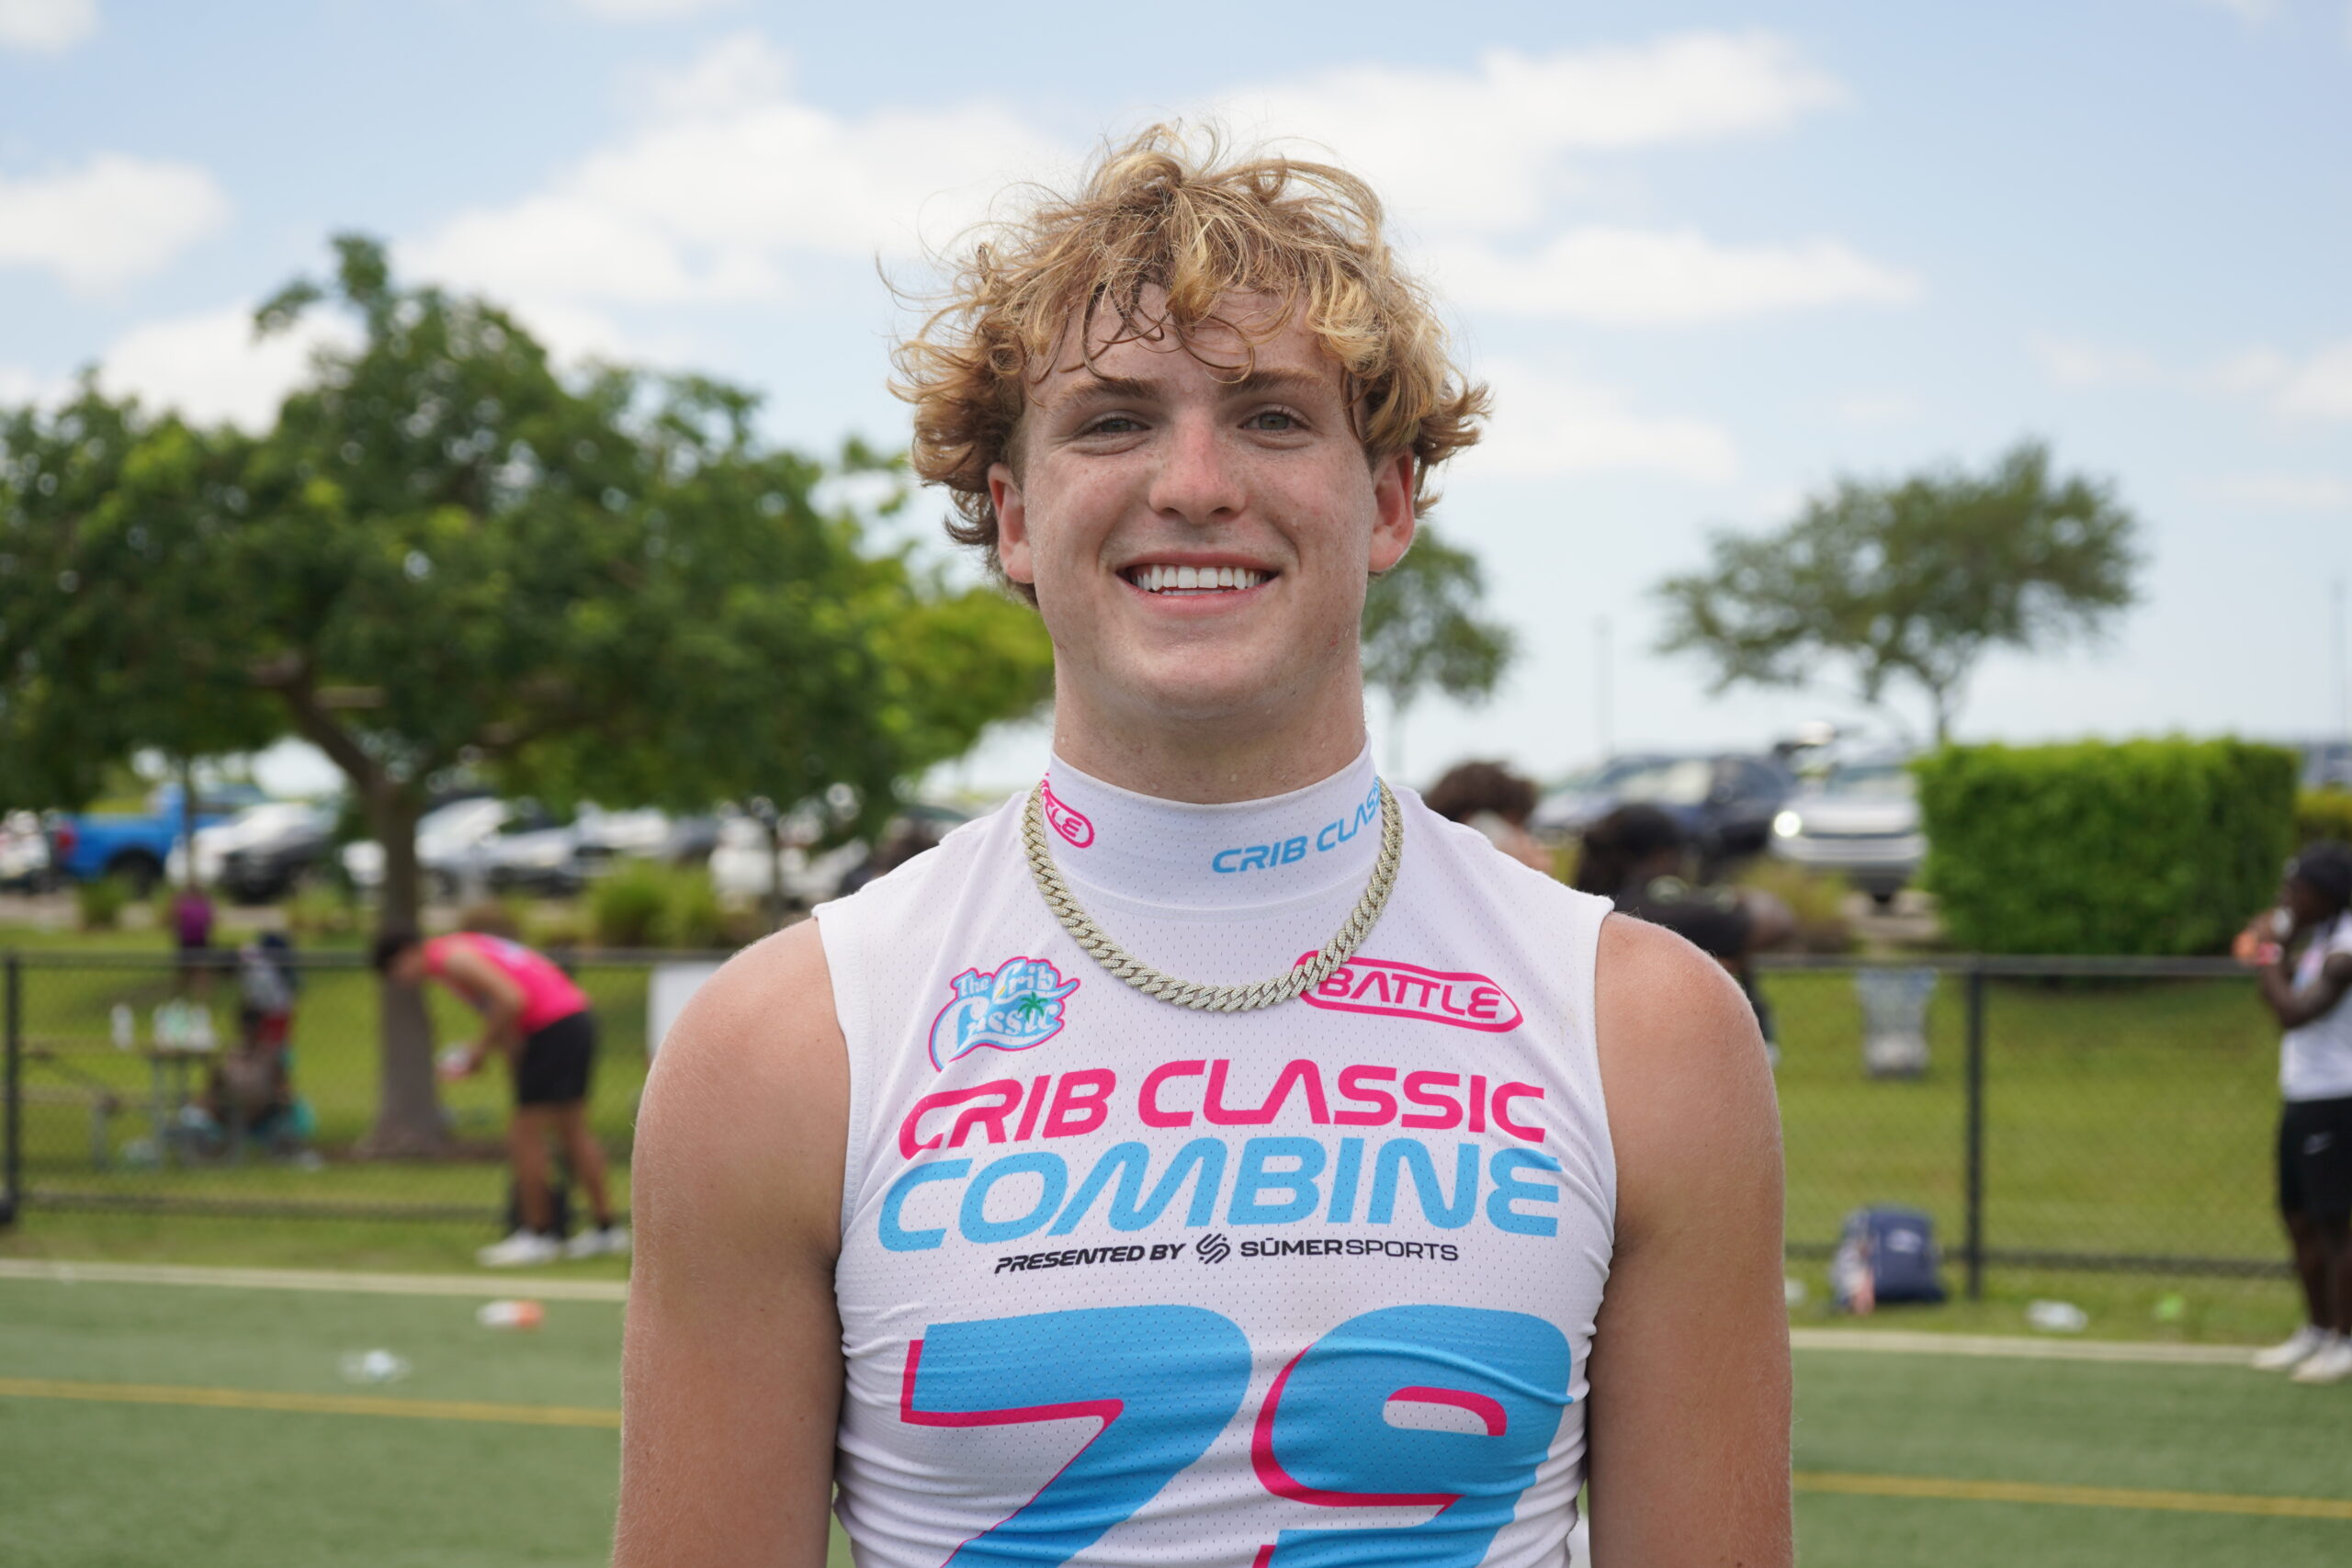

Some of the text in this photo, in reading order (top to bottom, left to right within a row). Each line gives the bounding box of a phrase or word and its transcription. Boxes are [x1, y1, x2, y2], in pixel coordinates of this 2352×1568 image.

[1212, 835, 1308, 874] CRIB
[955, 961, 1058, 1005] The Crib
[1317, 966, 1501, 1020] BATTLE
[899, 1058, 1546, 1160] CRIB CLASSIC
[877, 1136, 1563, 1252] COMBINE
[994, 1245, 1146, 1274] PRESENTED
[1149, 1243, 1187, 1261] BY
[900, 1303, 1574, 1568] 79
